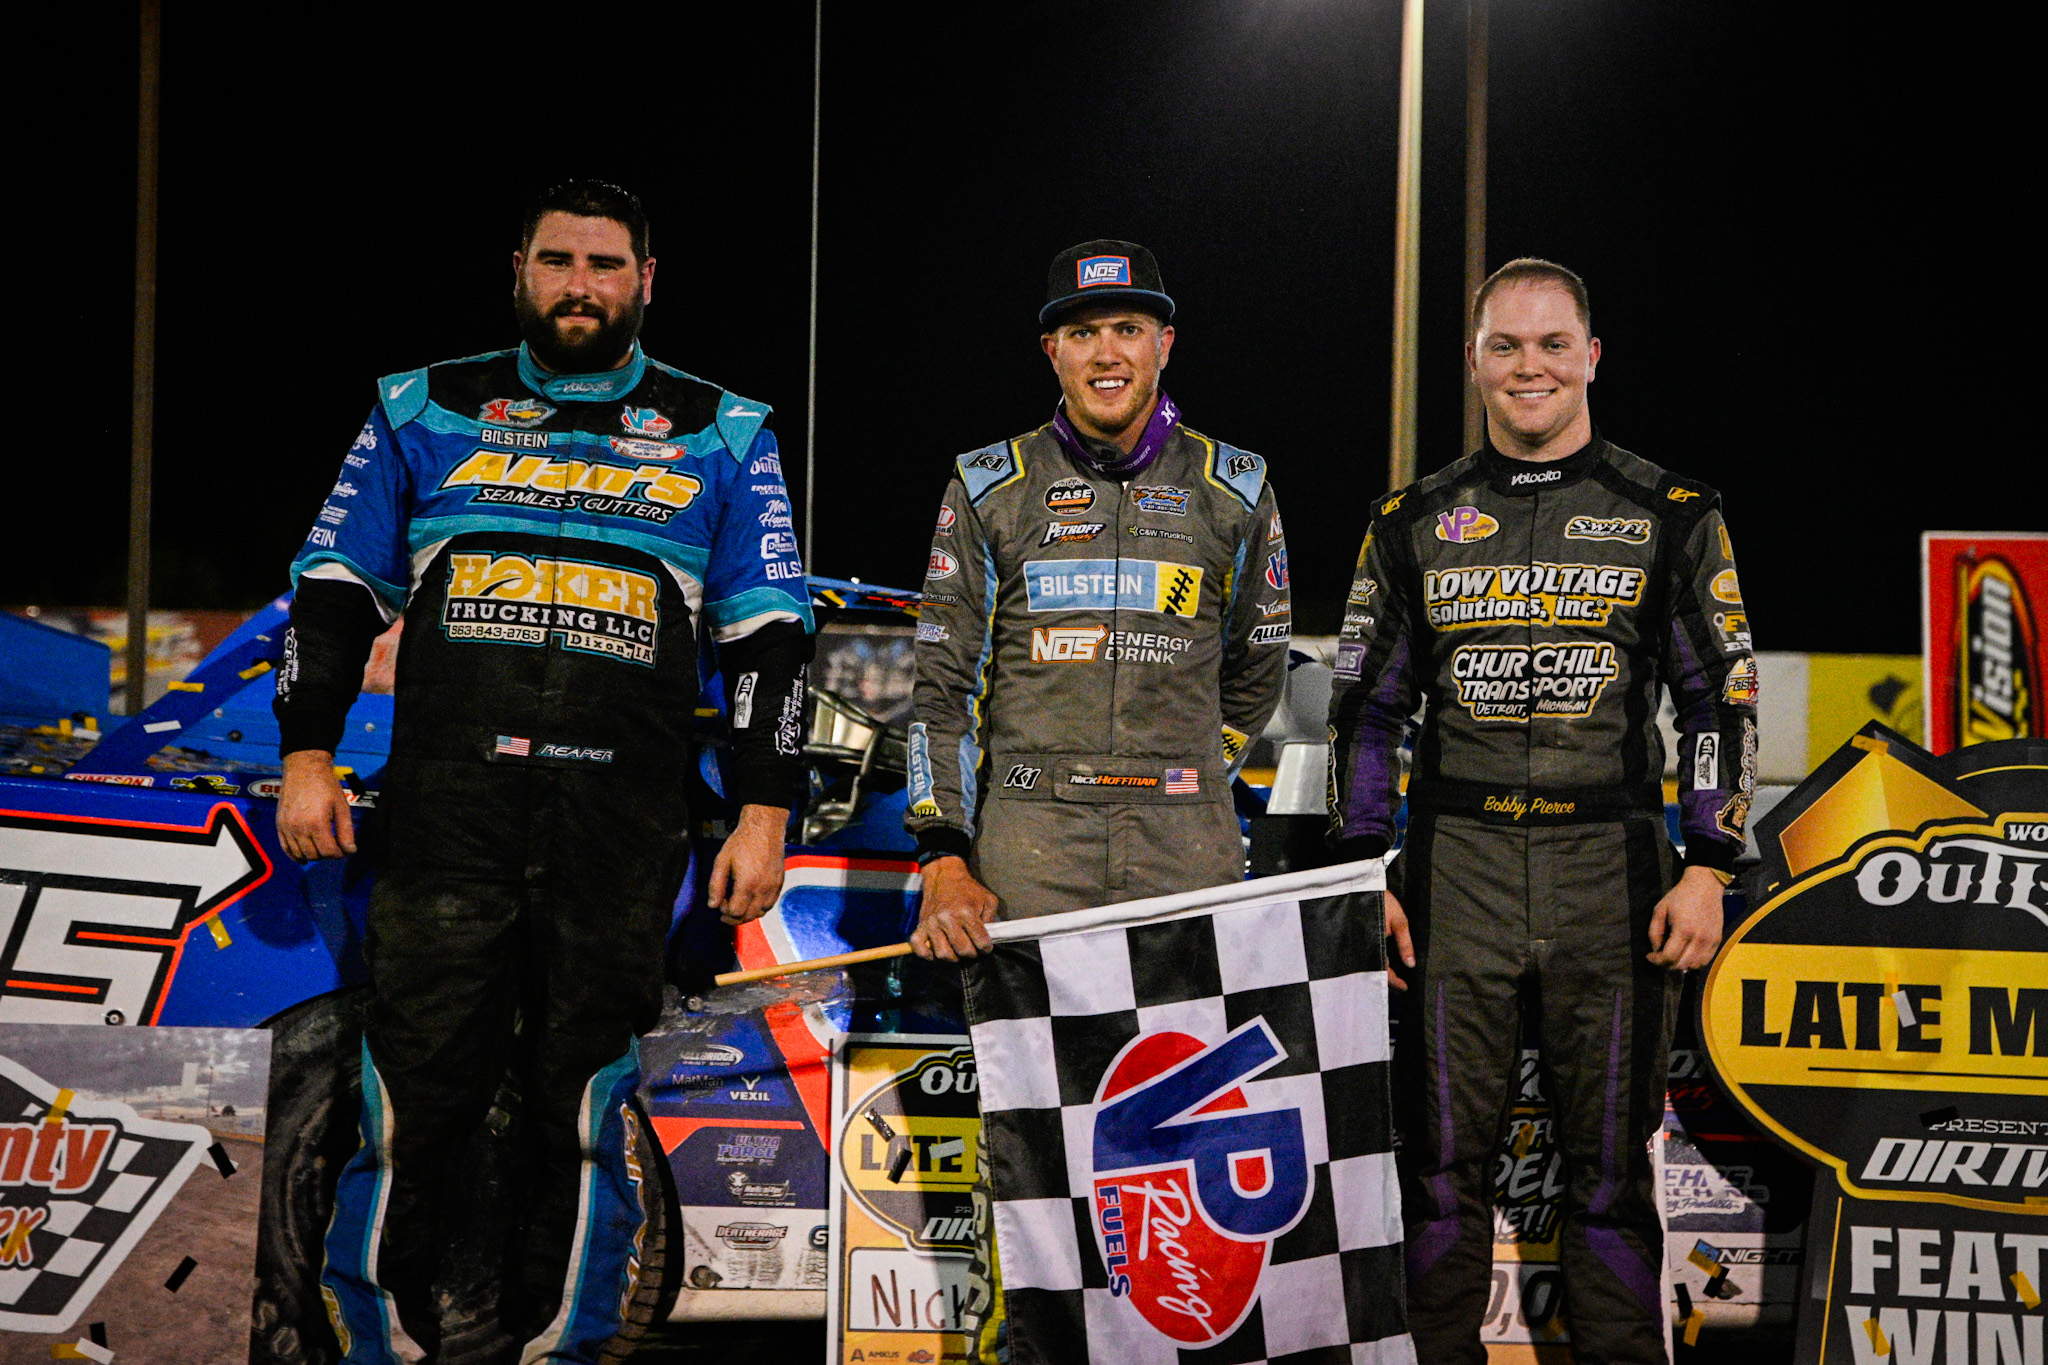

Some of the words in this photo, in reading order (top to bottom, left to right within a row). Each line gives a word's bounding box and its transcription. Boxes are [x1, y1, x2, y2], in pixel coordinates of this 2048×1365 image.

[1084, 262, 1123, 280] NOS
[481, 429, 549, 449] BILSTEIN
[441, 450, 702, 509] Alan's
[1227, 455, 1259, 479] K1
[478, 488, 578, 508] SEAMLESS
[585, 498, 673, 521] GUTTERS
[1051, 489, 1093, 501] CASE
[1042, 521, 1104, 545] PETROFF
[1138, 527, 1158, 537] C&W
[1158, 530, 1194, 543] Trucking
[1437, 506, 1479, 543] VP
[929, 556, 950, 570] ELL
[450, 554, 656, 620] HOKER
[1040, 574, 1142, 596] BILSTEIN
[1426, 568, 1496, 601] LOW
[1500, 565, 1641, 599] VOLTAGE
[451, 602, 597, 630] TRUCKING
[606, 616, 653, 642] LLC
[635, 644, 653, 662] IA
[1032, 625, 1109, 662] NOS
[1108, 631, 1193, 652] ENERGY
[1105, 646, 1176, 665] DRINK
[1462, 676, 1603, 700] TRANSPORT
[540, 744, 614, 761] REAPER
[911, 732, 926, 797] BILSTEIN
[1004, 764, 1041, 790] K1
[1483, 795, 1527, 821] Bobby
[1530, 797, 1576, 814] Pierce
[1740, 978, 1944, 1054] LATE
[730, 1091, 771, 1102] VEXIL
[1092, 1014, 1316, 1241] VP
[718, 1144, 778, 1159] FORCE
[860, 1133, 963, 1173] LATE
[1097, 1184, 1131, 1298] FUELS
[1120, 1177, 1219, 1339] Racing
